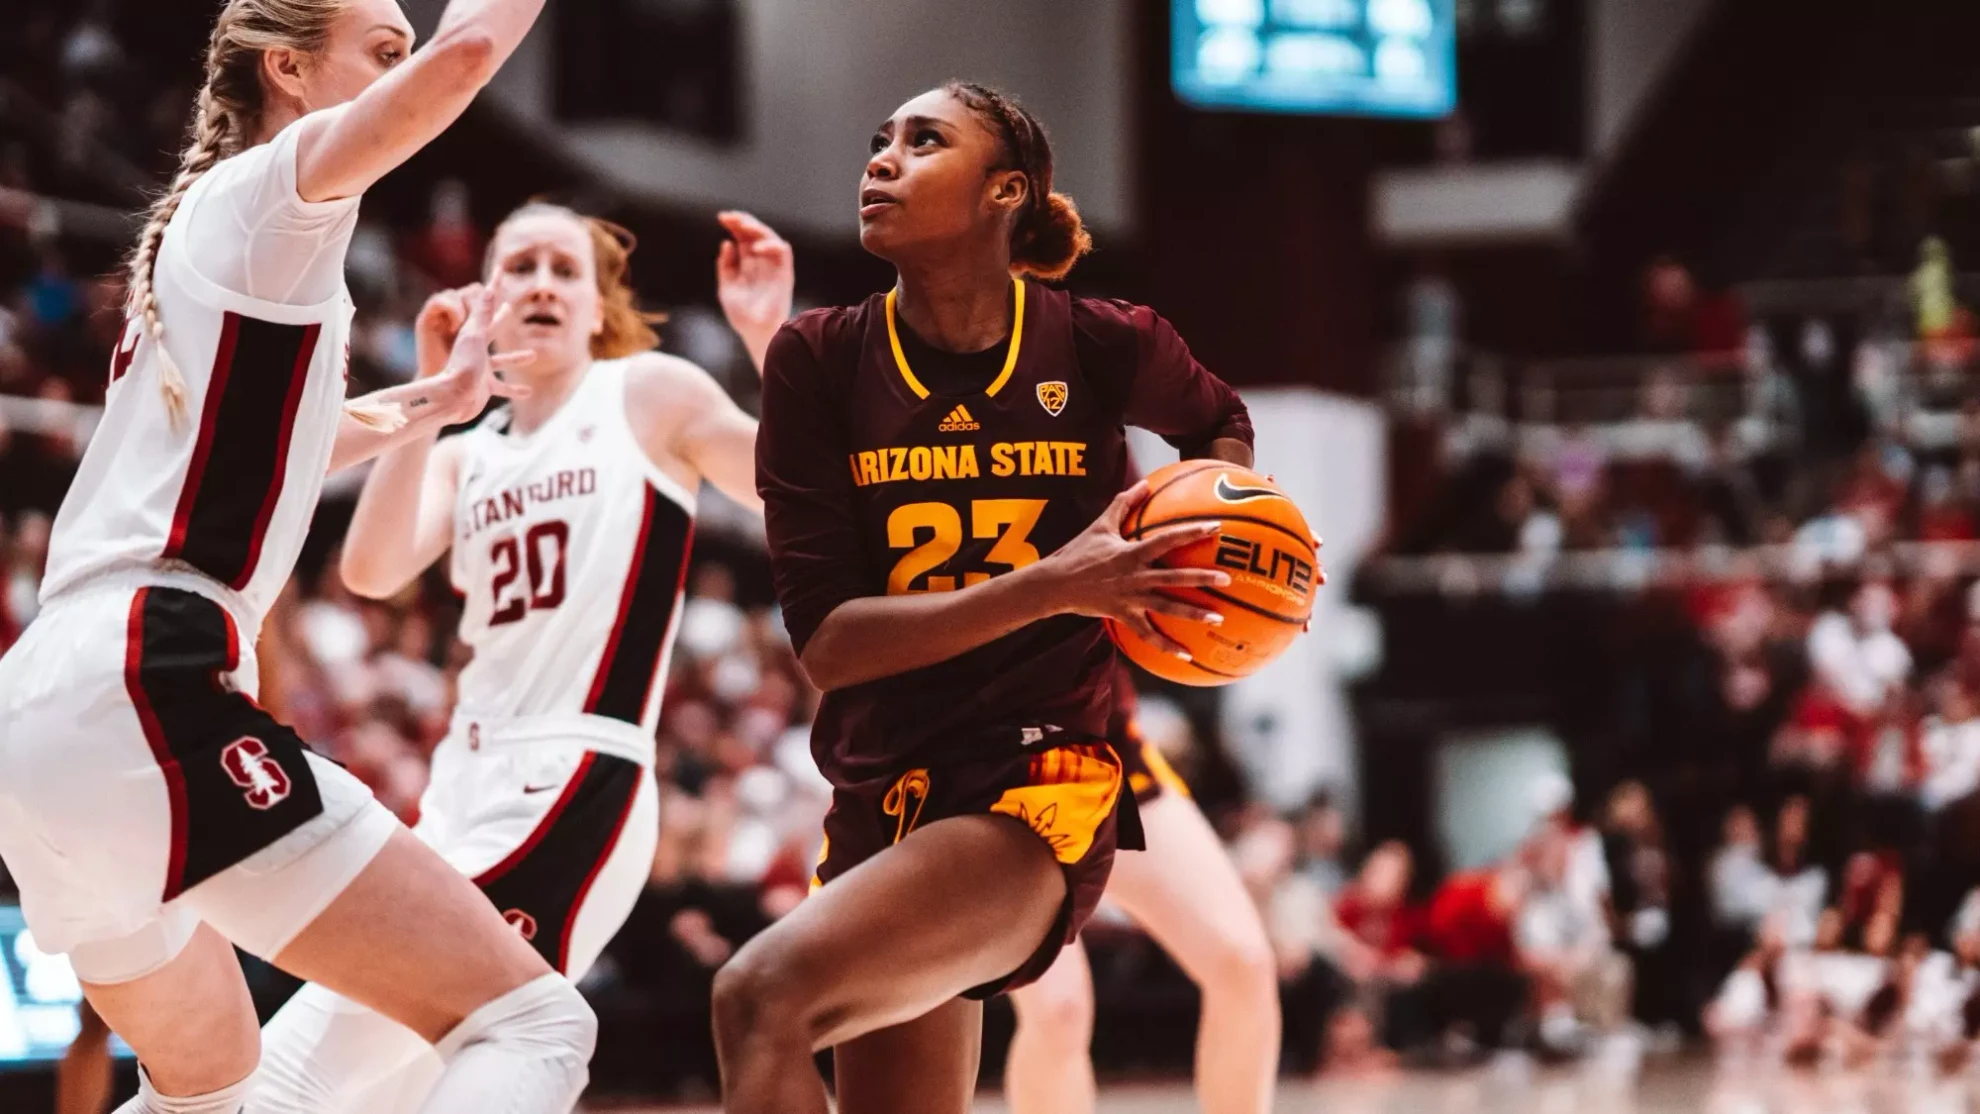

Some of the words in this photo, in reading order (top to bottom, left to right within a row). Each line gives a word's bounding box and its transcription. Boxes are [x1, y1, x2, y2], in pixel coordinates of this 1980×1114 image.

[938, 421, 981, 432] adidas
[1046, 397, 1061, 409] 12
[990, 441, 1087, 477] STATE
[463, 467, 596, 540] TANFORD
[488, 518, 570, 627] 20
[886, 498, 1049, 596] 23
[1215, 535, 1312, 594] ELITE
